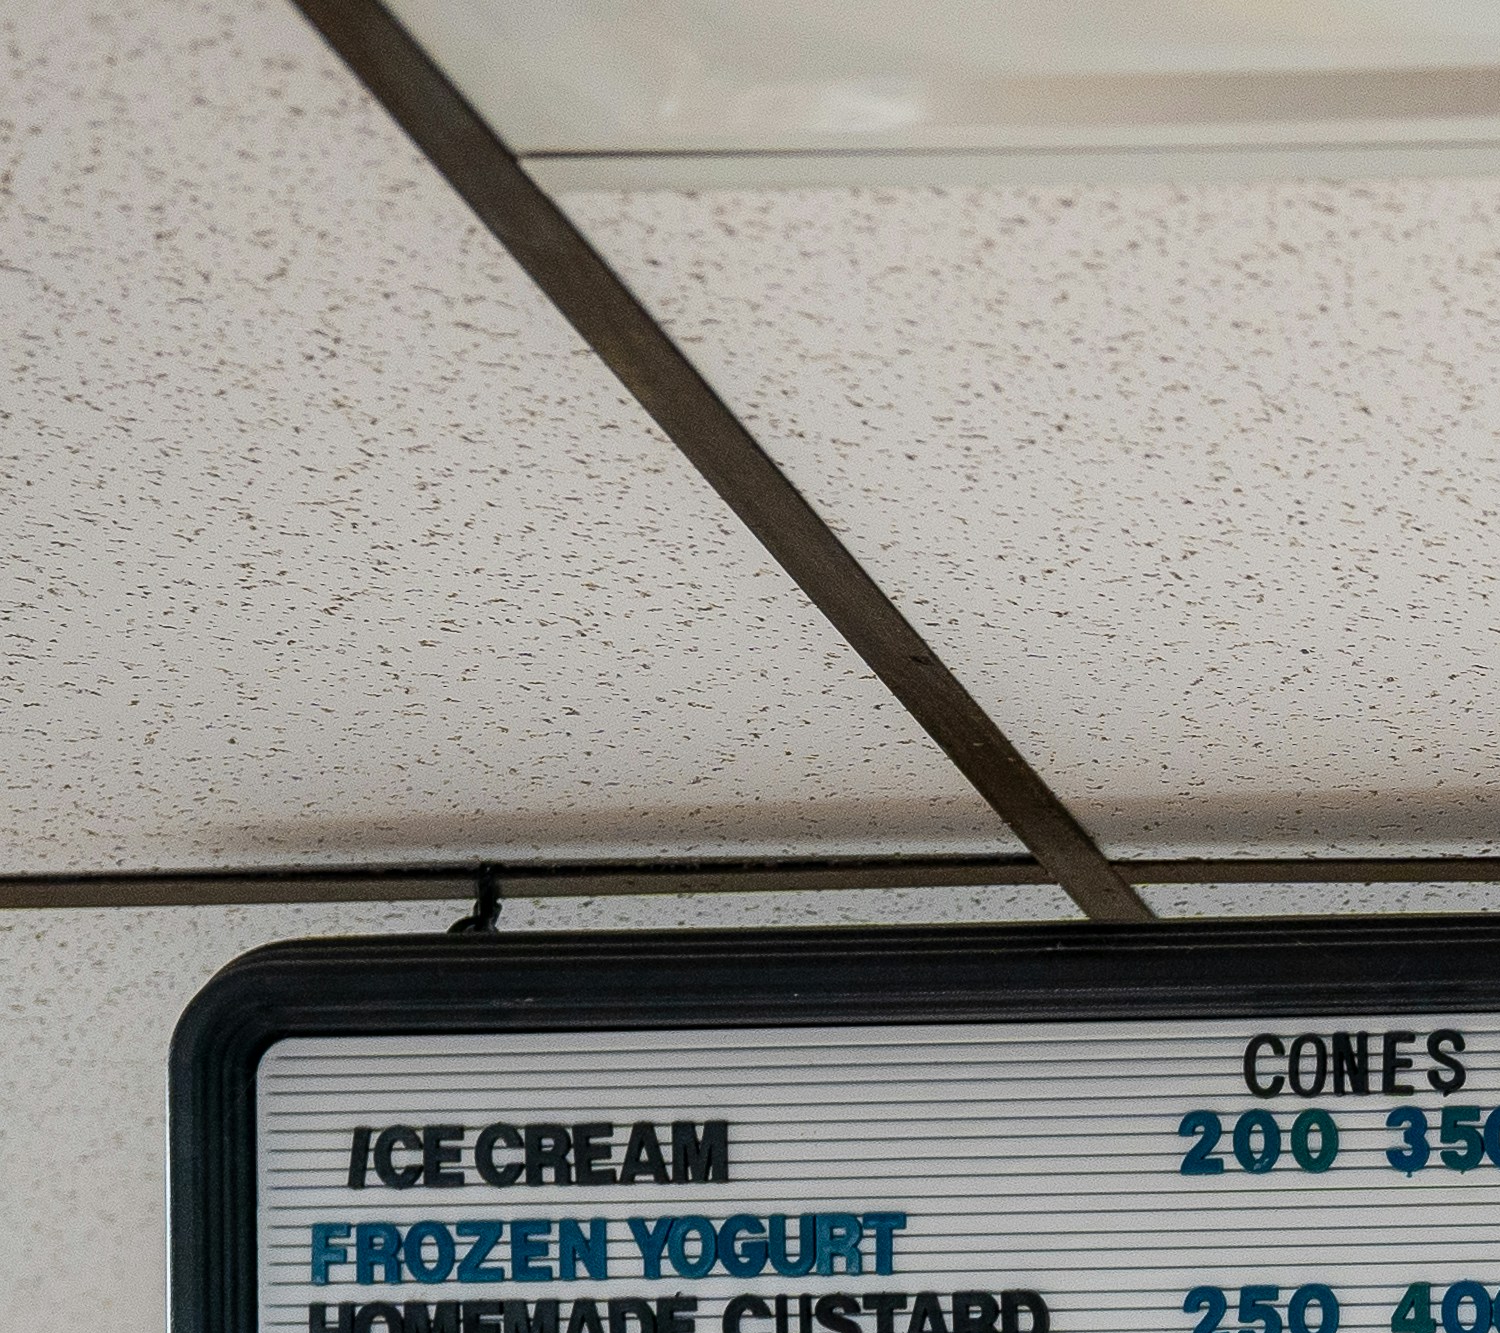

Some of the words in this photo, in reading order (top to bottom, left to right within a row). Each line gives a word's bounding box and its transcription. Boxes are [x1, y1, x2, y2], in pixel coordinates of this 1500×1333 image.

[1243, 1028, 1468, 1098] CONES
[1179, 1107, 1339, 1175] 200
[310, 1217, 607, 1284] FROZEN
[629, 1210, 907, 1279] YOGURT
